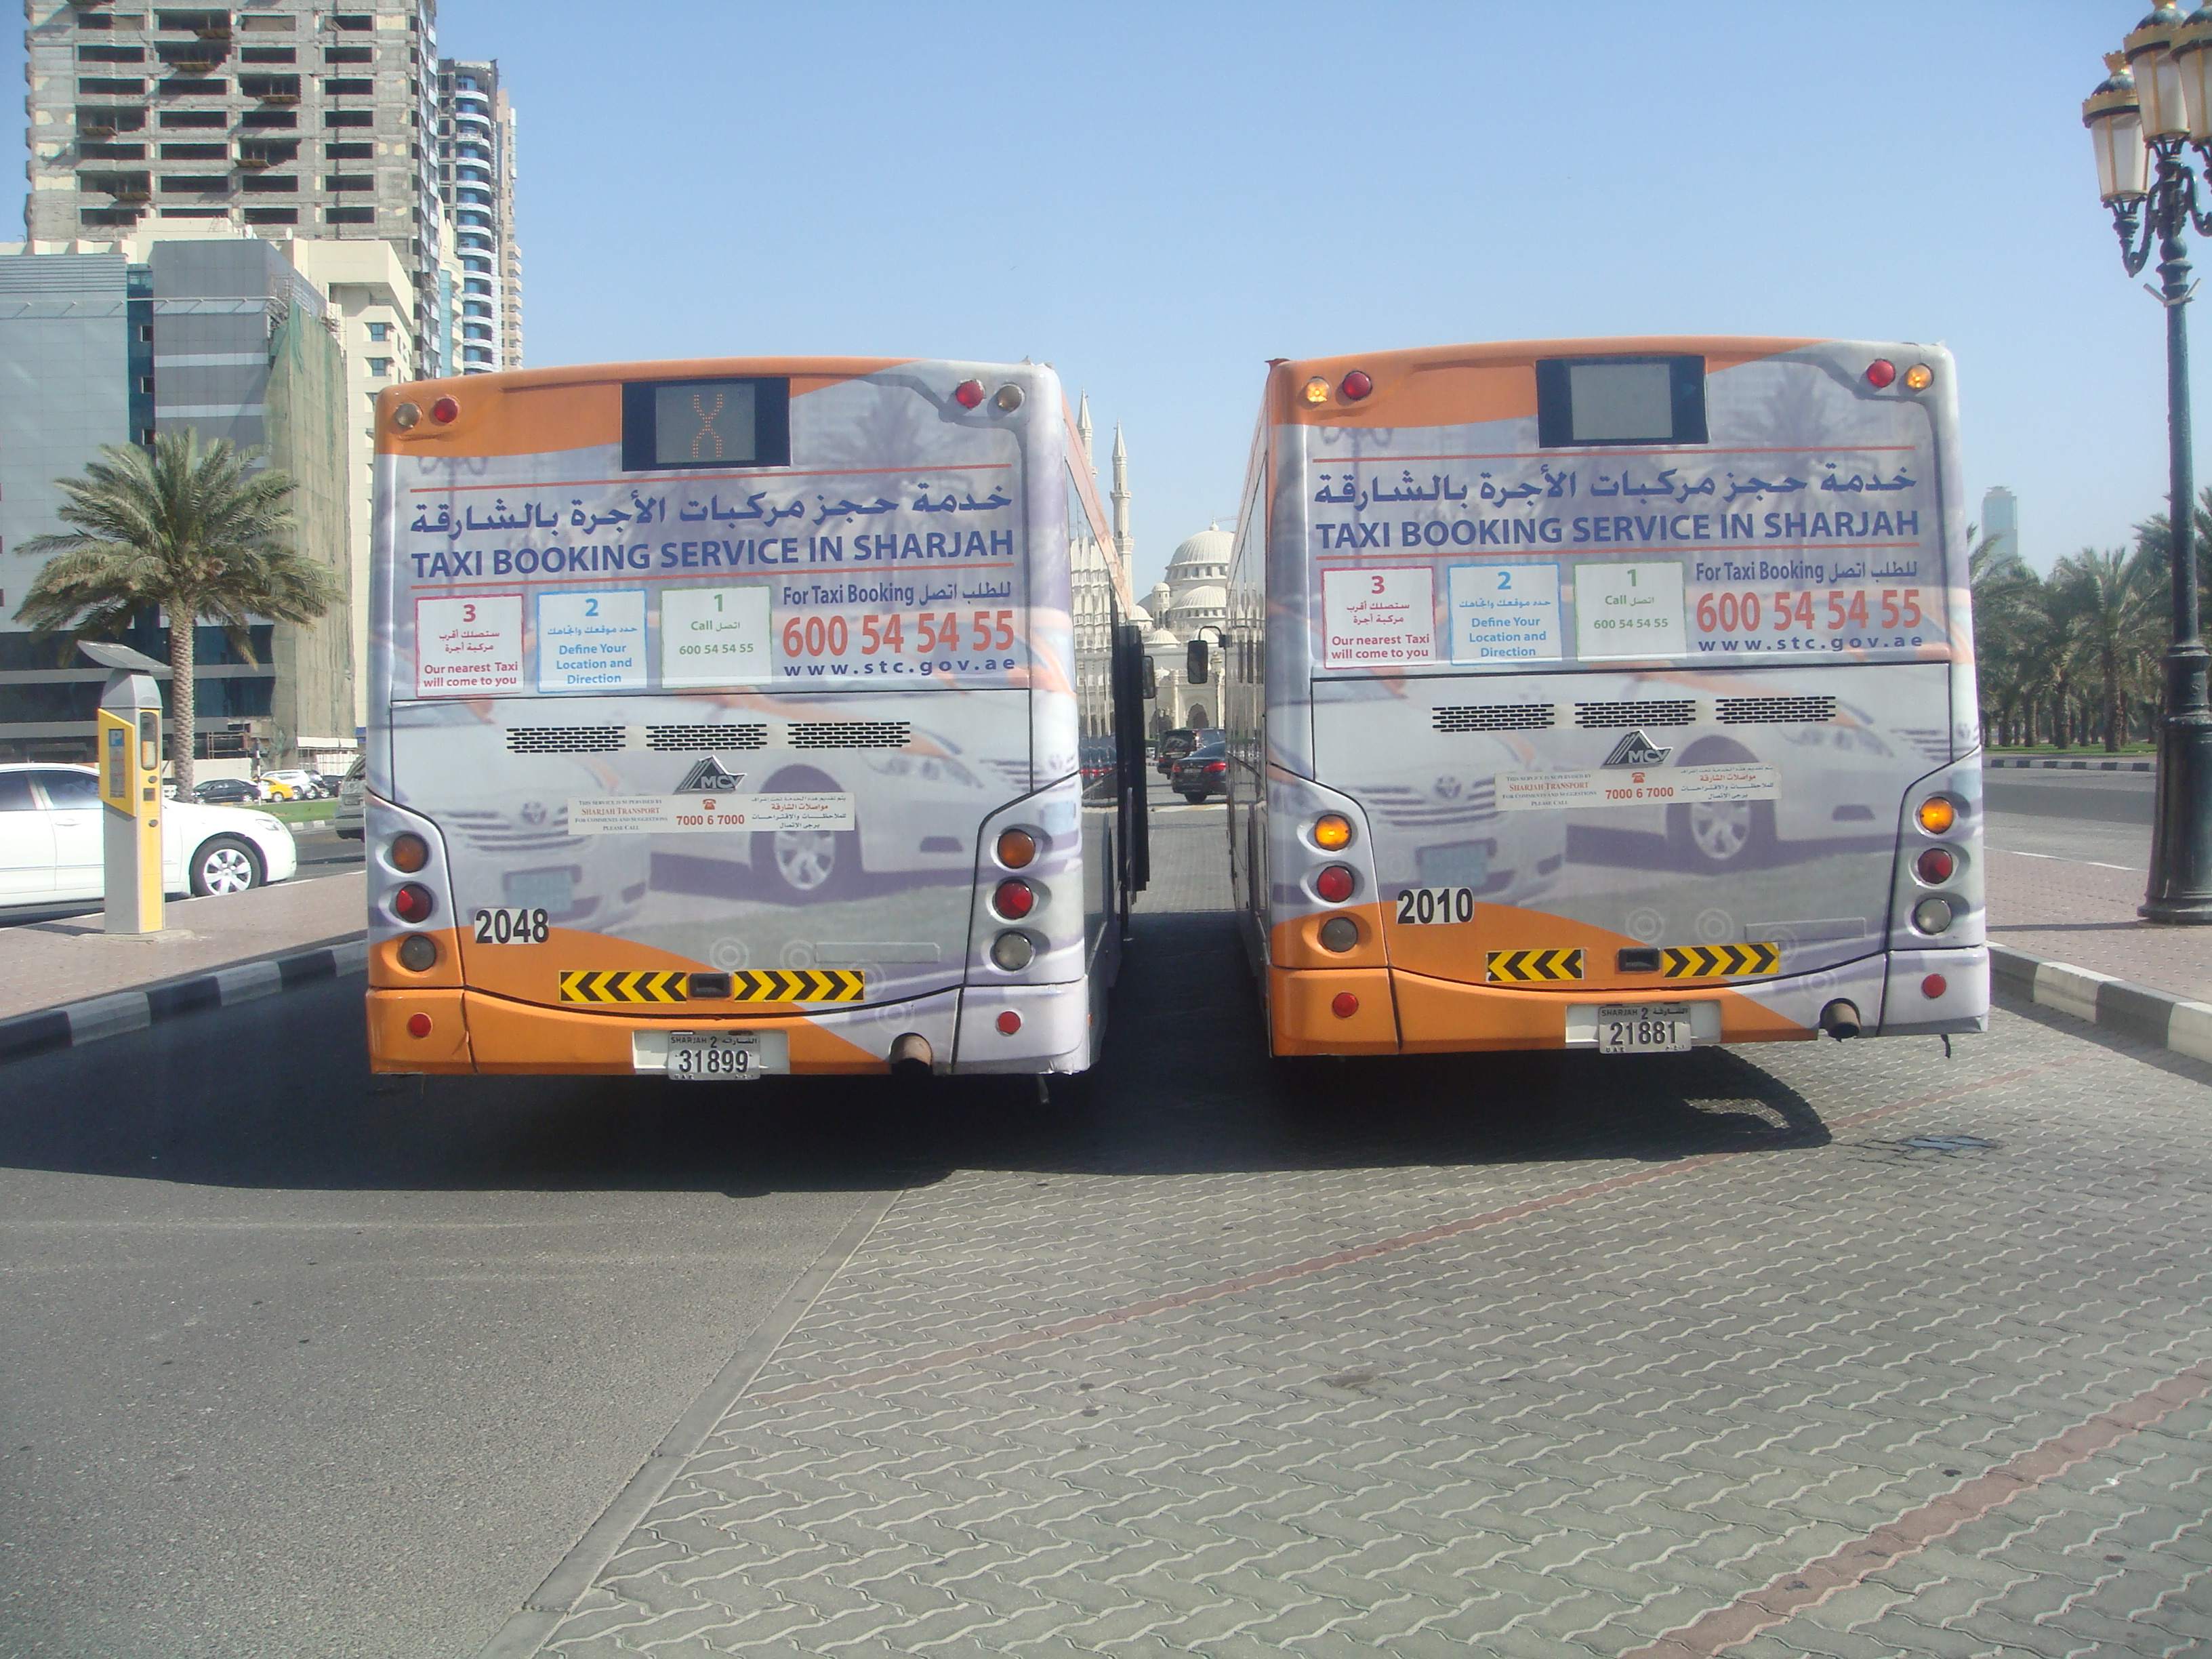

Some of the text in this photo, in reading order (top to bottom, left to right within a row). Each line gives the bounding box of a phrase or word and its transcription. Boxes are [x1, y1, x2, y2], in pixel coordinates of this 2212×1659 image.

[1314, 462, 1917, 512] خدمة حجز مركبات الأجرة بالشارقة
[411, 483, 1012, 540] خدمة حجز مركبات الأجرة بالشارقة
[1316, 510, 1919, 549] TAXI BOOKING SERVICE IN SHARJAH
[411, 530, 1013, 577] TAXI BOOKING SERVICE IN SHARJAH
[1627, 569, 1636, 587] 1
[1696, 560, 1823, 583] For Taxi Booking
[1830, 561, 1917, 583] للطلب اتصل
[1372, 576, 1385, 594] 3
[1498, 572, 1511, 590] 2
[783, 583, 914, 606] For Taxi Booking
[919, 581, 1011, 605] للطلب اتصل
[1605, 595, 1626, 605] Call
[586, 598, 598, 617] 2
[714, 594, 722, 611] 1
[1630, 596, 1654, 607] اتصل
[463, 605, 476, 622] 3
[1697, 589, 1921, 632] 600 54 54 55
[691, 620, 712, 631] Call
[716, 621, 740, 632] اتصل
[1472, 617, 1540, 628] Define Your
[1594, 618, 1668, 629] 600 54 54 55
[783, 611, 1014, 657] 600 54 54 55
[1332, 634, 1429, 646] Our nearest Taxi
[1470, 631, 1546, 642] Location and
[559, 644, 626, 655] Define Your
[679, 643, 754, 655] 600 54 54 55
[1699, 636, 1923, 652] www.stc.gov.ae
[1332, 649, 1428, 659] will come to you
[1481, 647, 1536, 657] Direction
[425, 661, 518, 674] Our nearest Taxi
[556, 658, 632, 670] Location and
[784, 658, 1015, 676] www.stc.gov.ae
[424, 676, 516, 687] will come to you
[567, 674, 621, 684] Direction
[1628, 750, 1671, 764] MCV
[701, 775, 744, 789] MCV
[1605, 787, 1673, 799] 7000 6 7000
[676, 815, 744, 825] 7000 6 7000
[1398, 888, 1473, 924] 2010
[476, 909, 549, 943] 2048
[1641, 1008, 1648, 1019] 2
[1610, 1021, 1675, 1045] 21881
[710, 1036, 717, 1048] 2
[679, 1050, 748, 1073] 31899
